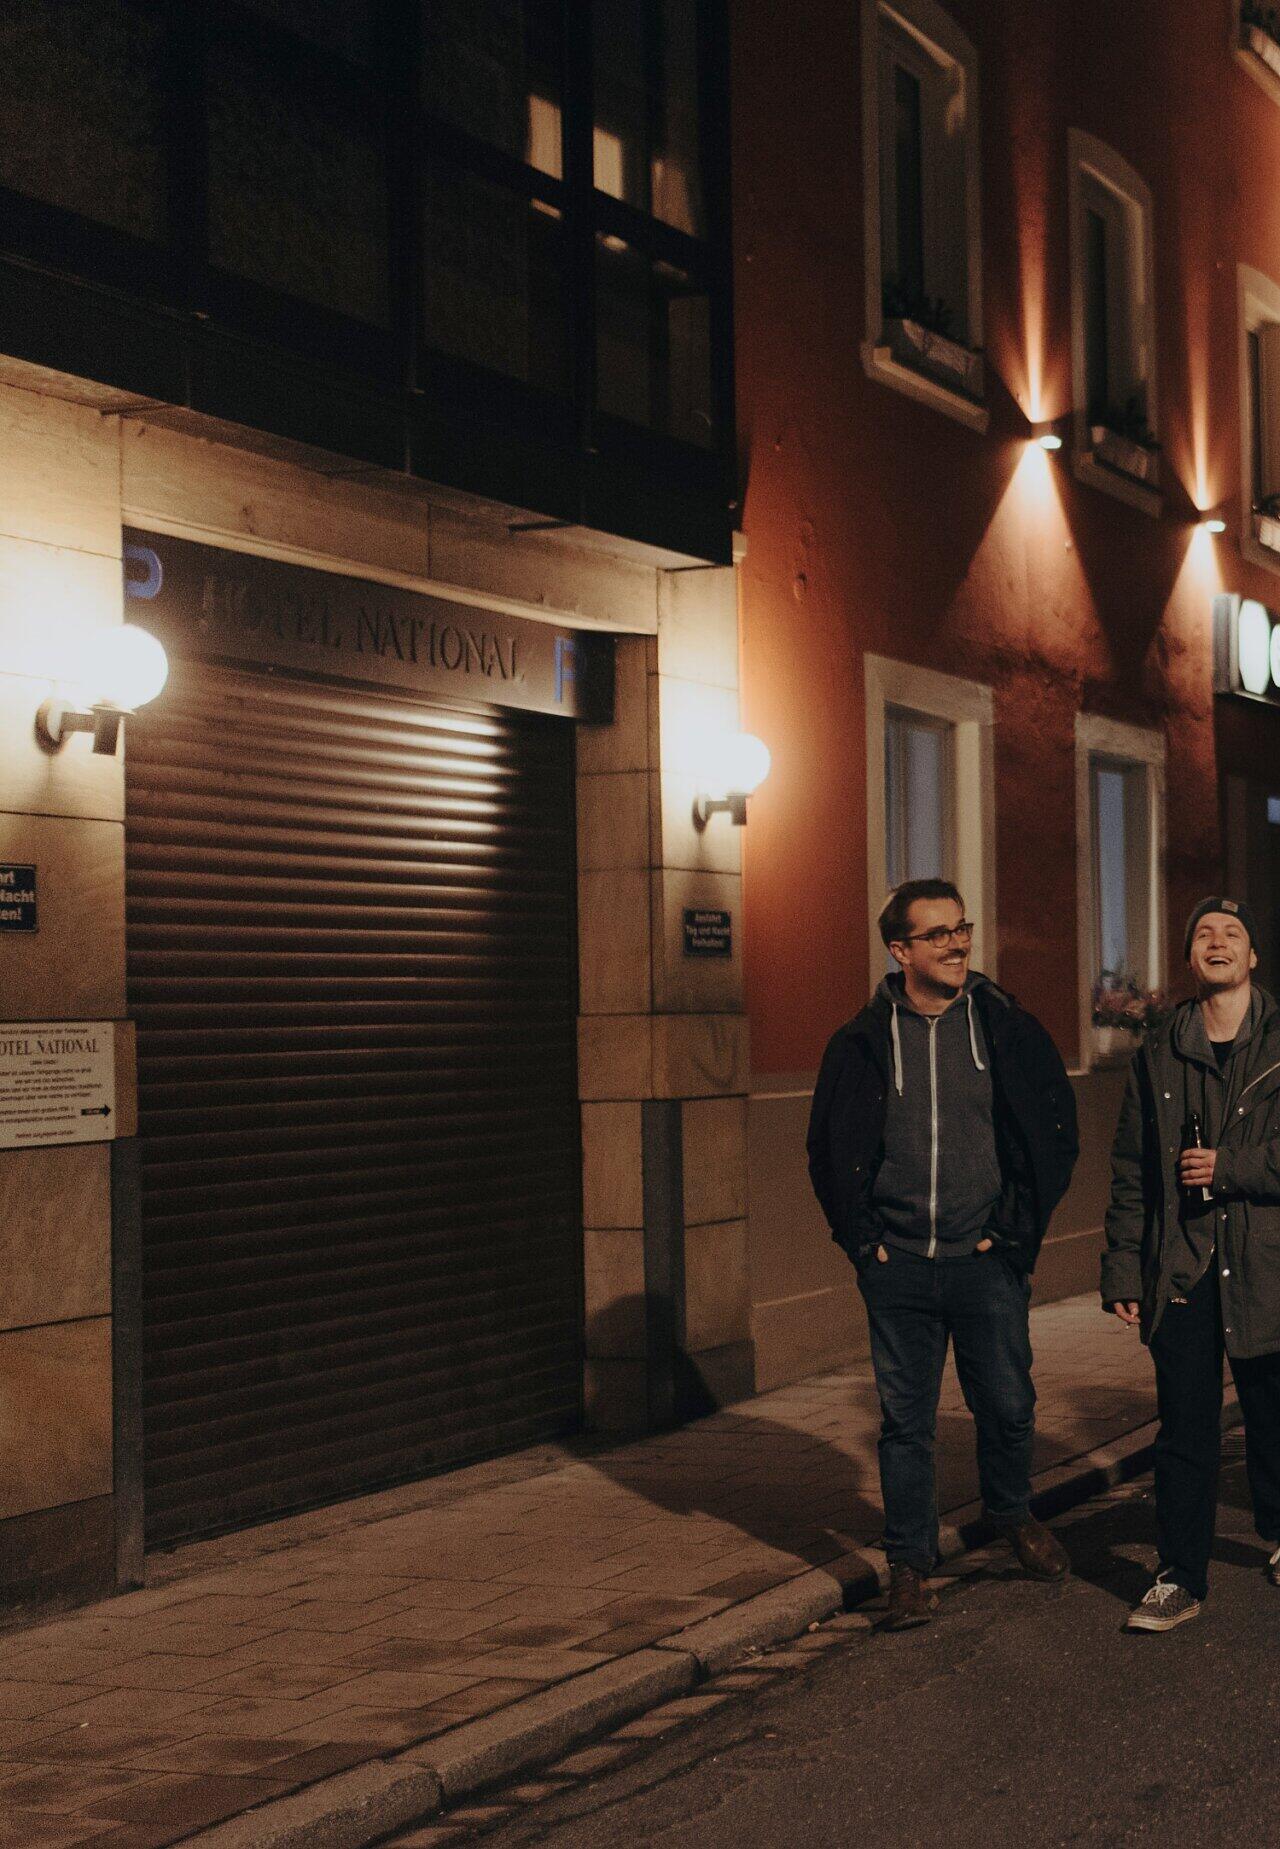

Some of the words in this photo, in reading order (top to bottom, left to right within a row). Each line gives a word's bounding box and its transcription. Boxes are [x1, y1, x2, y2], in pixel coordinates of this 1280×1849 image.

[201, 574, 343, 650] HOTEL
[355, 605, 526, 684] NATIONAL
[36, 1038, 99, 1055] NATIONAL
